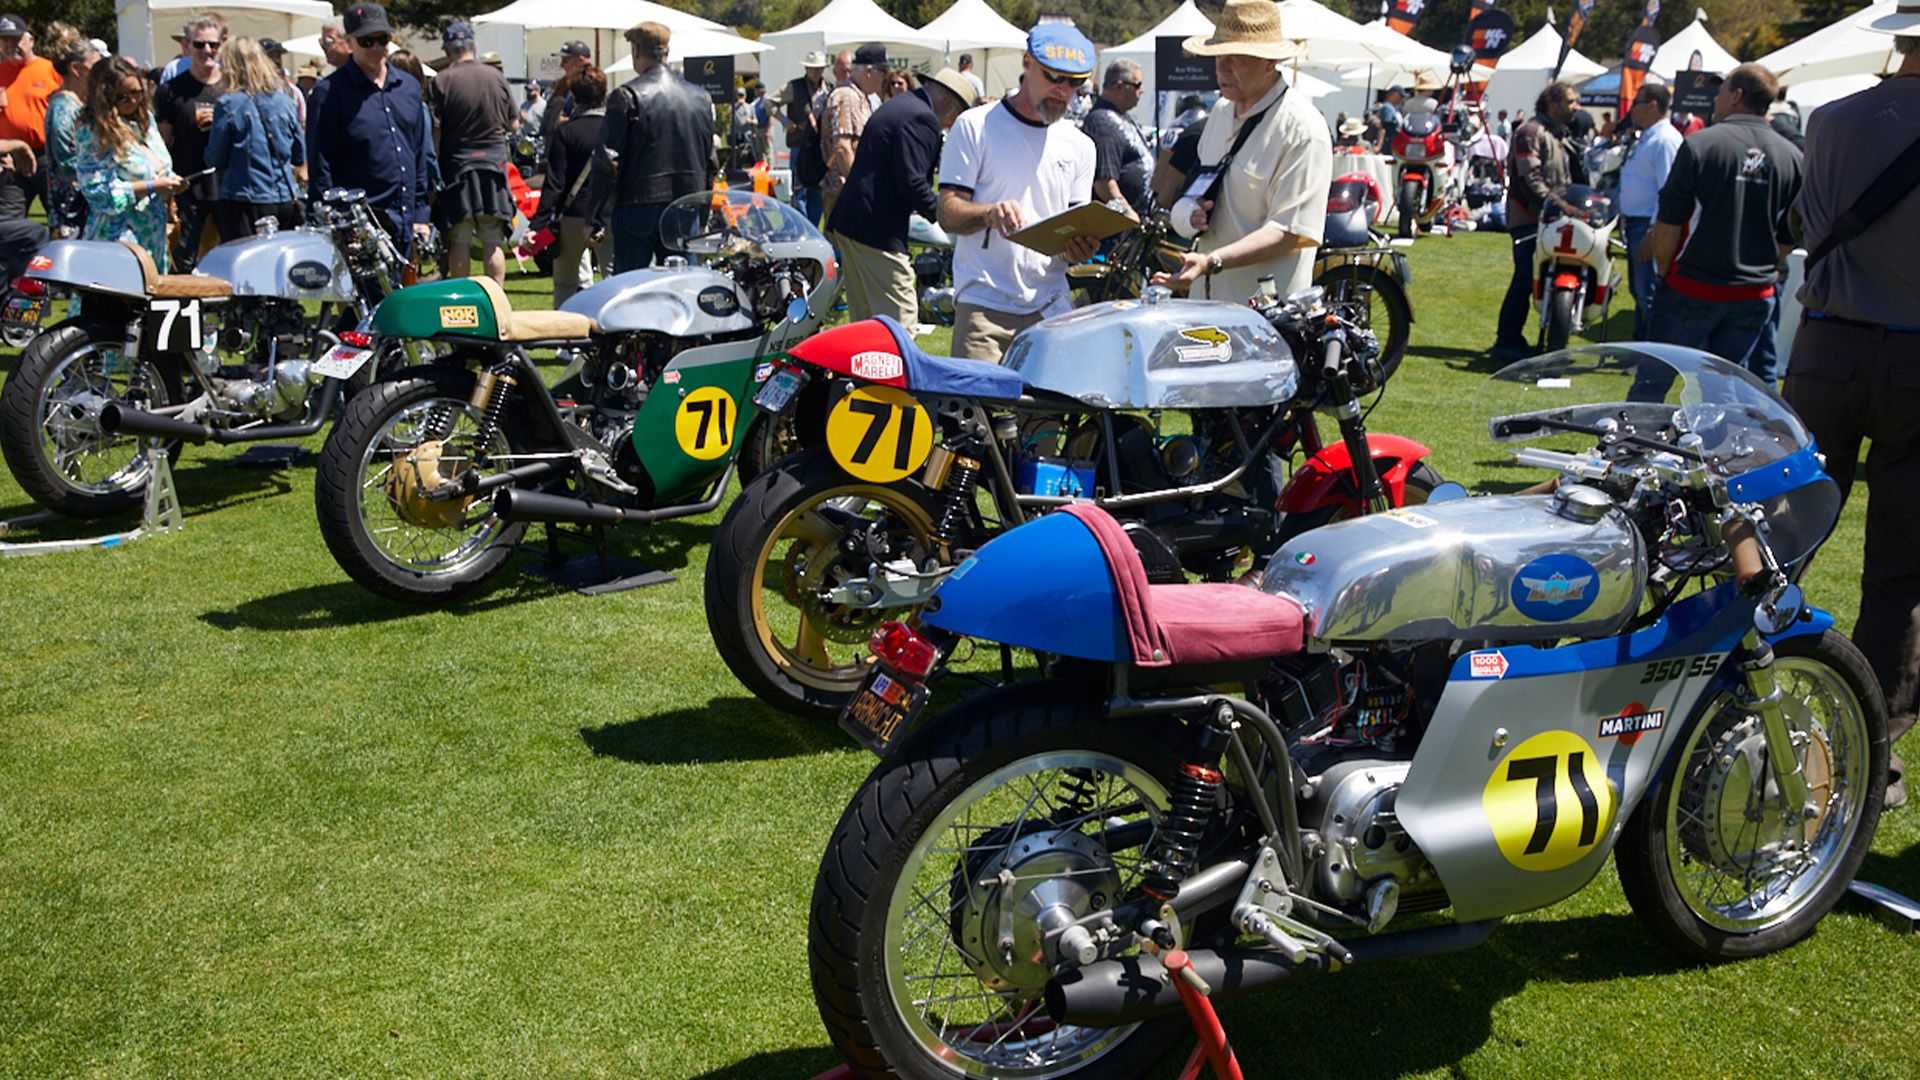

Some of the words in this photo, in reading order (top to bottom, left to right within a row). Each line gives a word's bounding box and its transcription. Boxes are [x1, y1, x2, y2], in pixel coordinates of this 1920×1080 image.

[1553, 223, 1577, 254] 1
[150, 299, 201, 351] 71
[686, 397, 729, 451] 71
[849, 397, 917, 471] 71
[1474, 656, 1498, 666] 1000
[1640, 658, 1686, 684] 350
[1687, 654, 1721, 678] SS
[1600, 711, 1662, 736] MARTINI
[1506, 751, 1600, 856] 71
